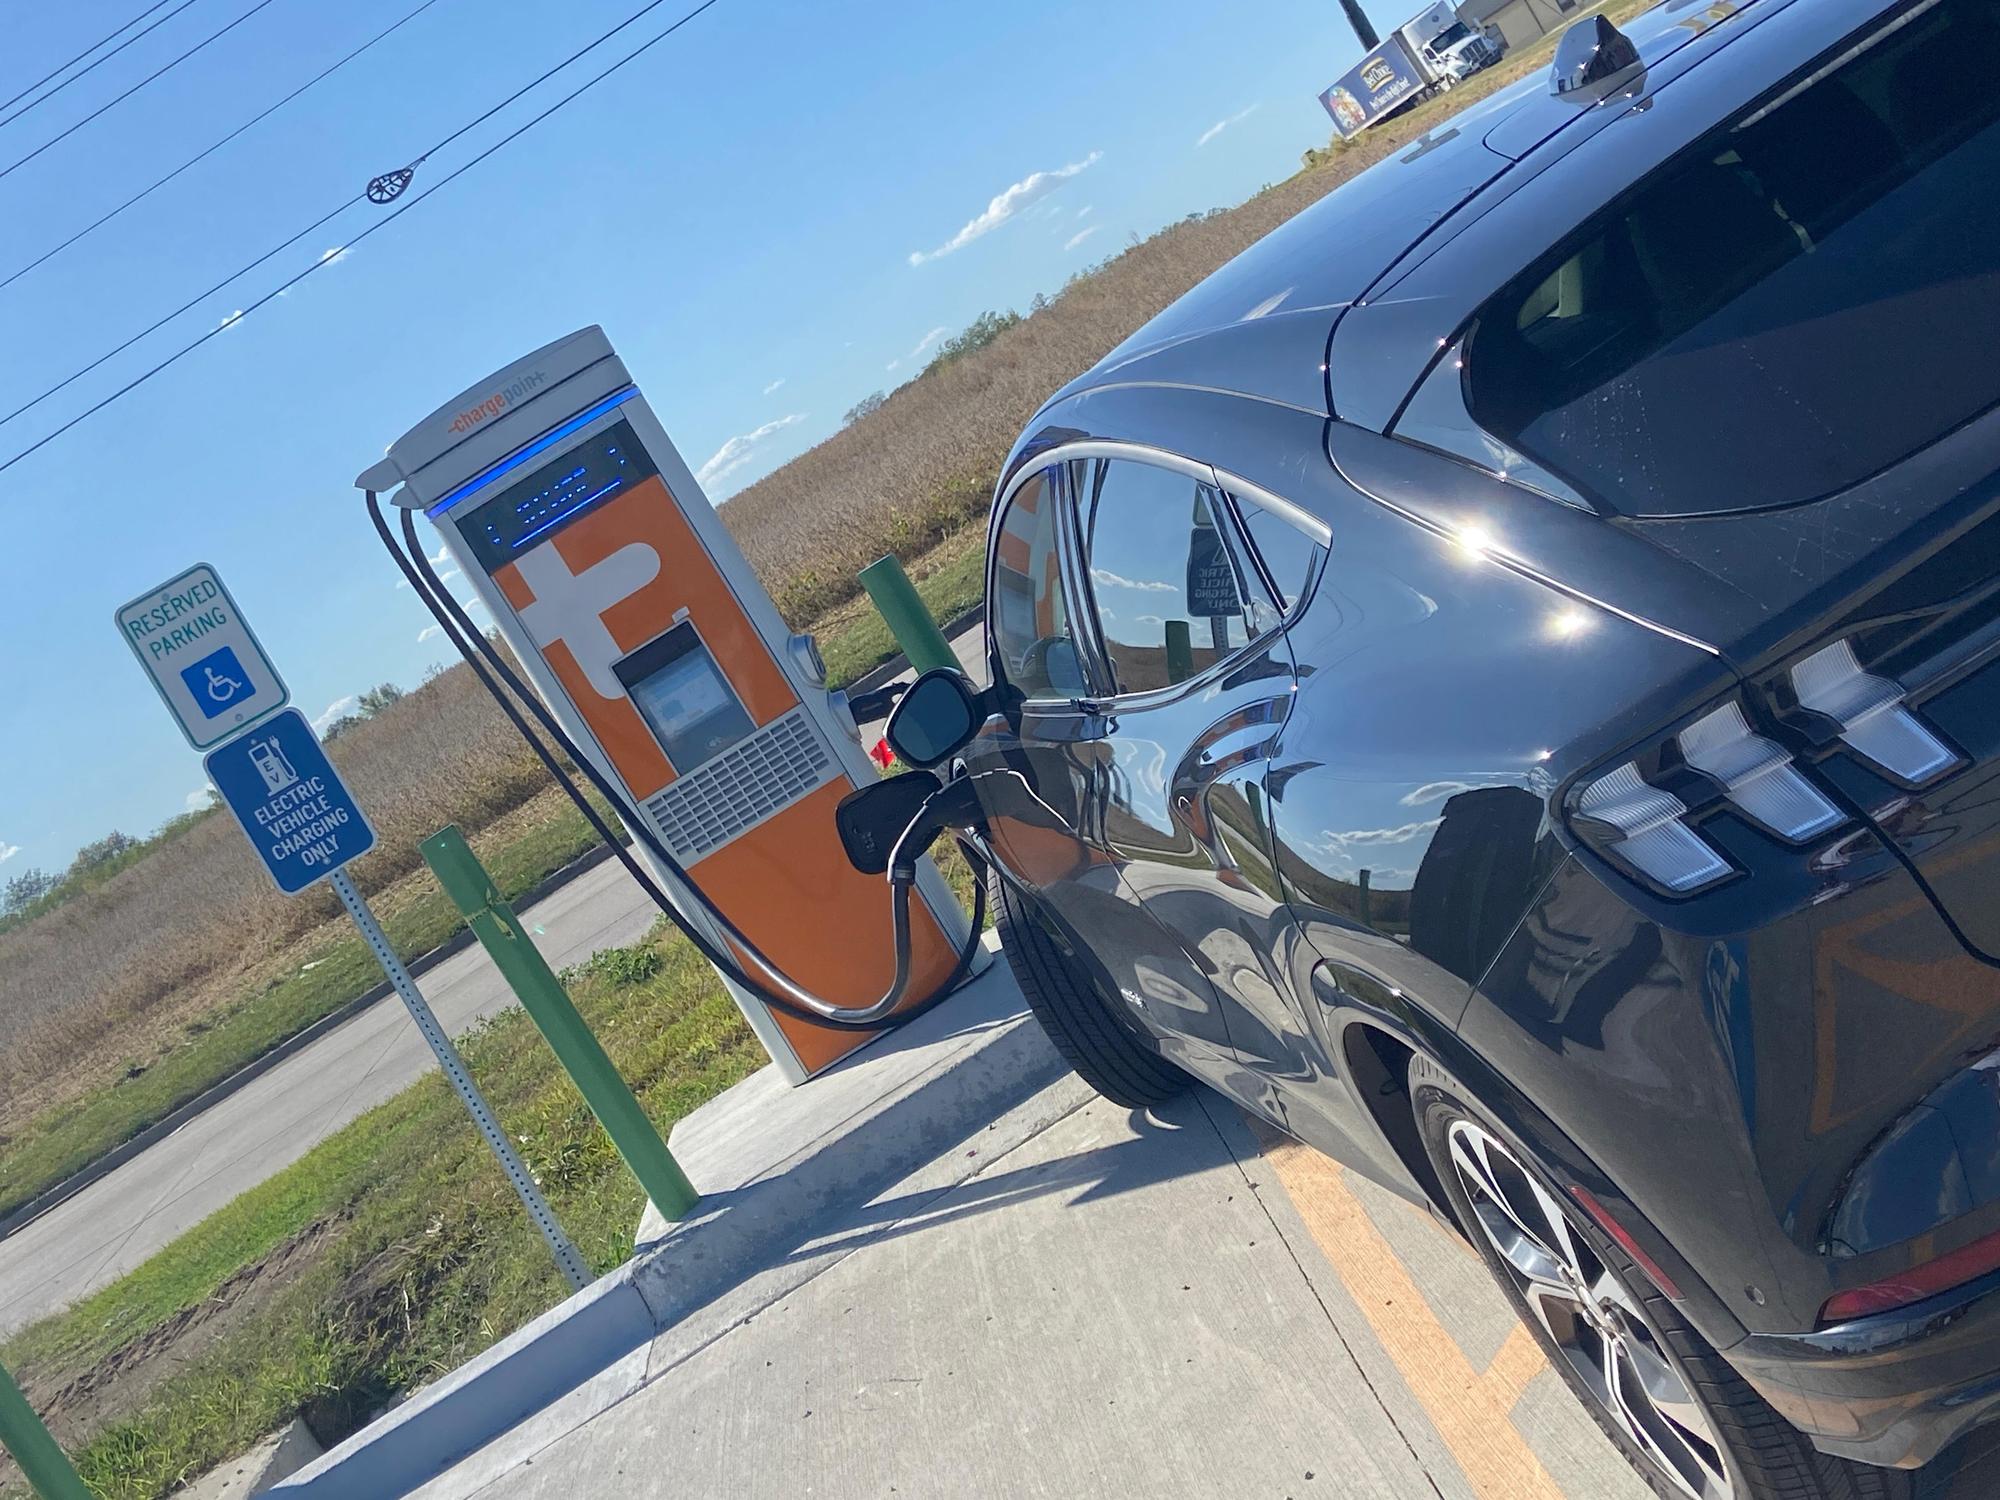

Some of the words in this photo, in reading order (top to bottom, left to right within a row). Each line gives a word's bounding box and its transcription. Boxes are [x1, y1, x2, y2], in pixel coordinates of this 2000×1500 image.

[128, 580, 217, 640] RESERVED
[149, 607, 227, 660] PARKING
[254, 776, 325, 825] ELECTRIC
[268, 794, 332, 839] VEHICLE
[272, 807, 349, 860] CHARGING
[301, 834, 339, 866] ONLY
